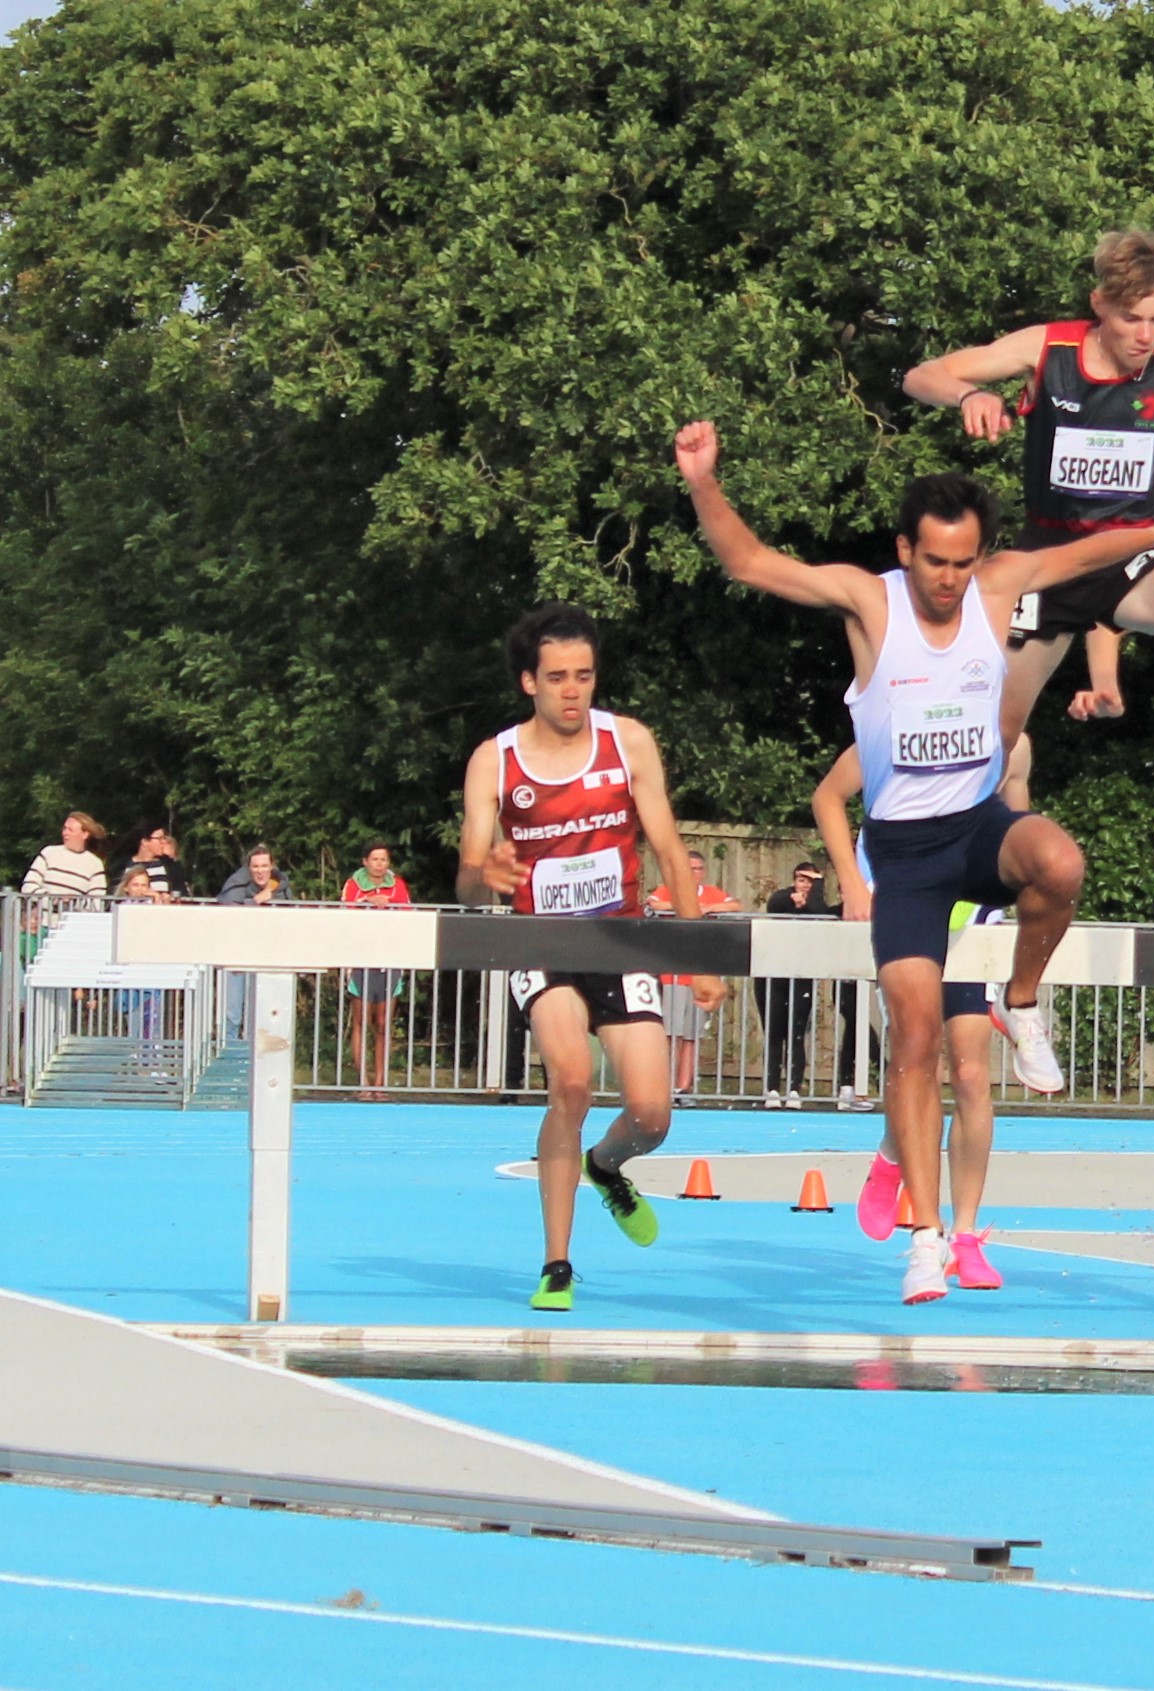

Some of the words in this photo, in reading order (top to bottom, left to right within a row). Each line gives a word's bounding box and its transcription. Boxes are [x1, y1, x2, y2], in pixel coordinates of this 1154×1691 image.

[1058, 456, 1146, 489] SERGEANT
[899, 725, 986, 763] ECKERSLEY
[511, 810, 628, 841] GIBRALTAR
[540, 883, 572, 910] LOPEZ
[573, 873, 617, 908] MONTERO
[636, 979, 653, 1005] 3
